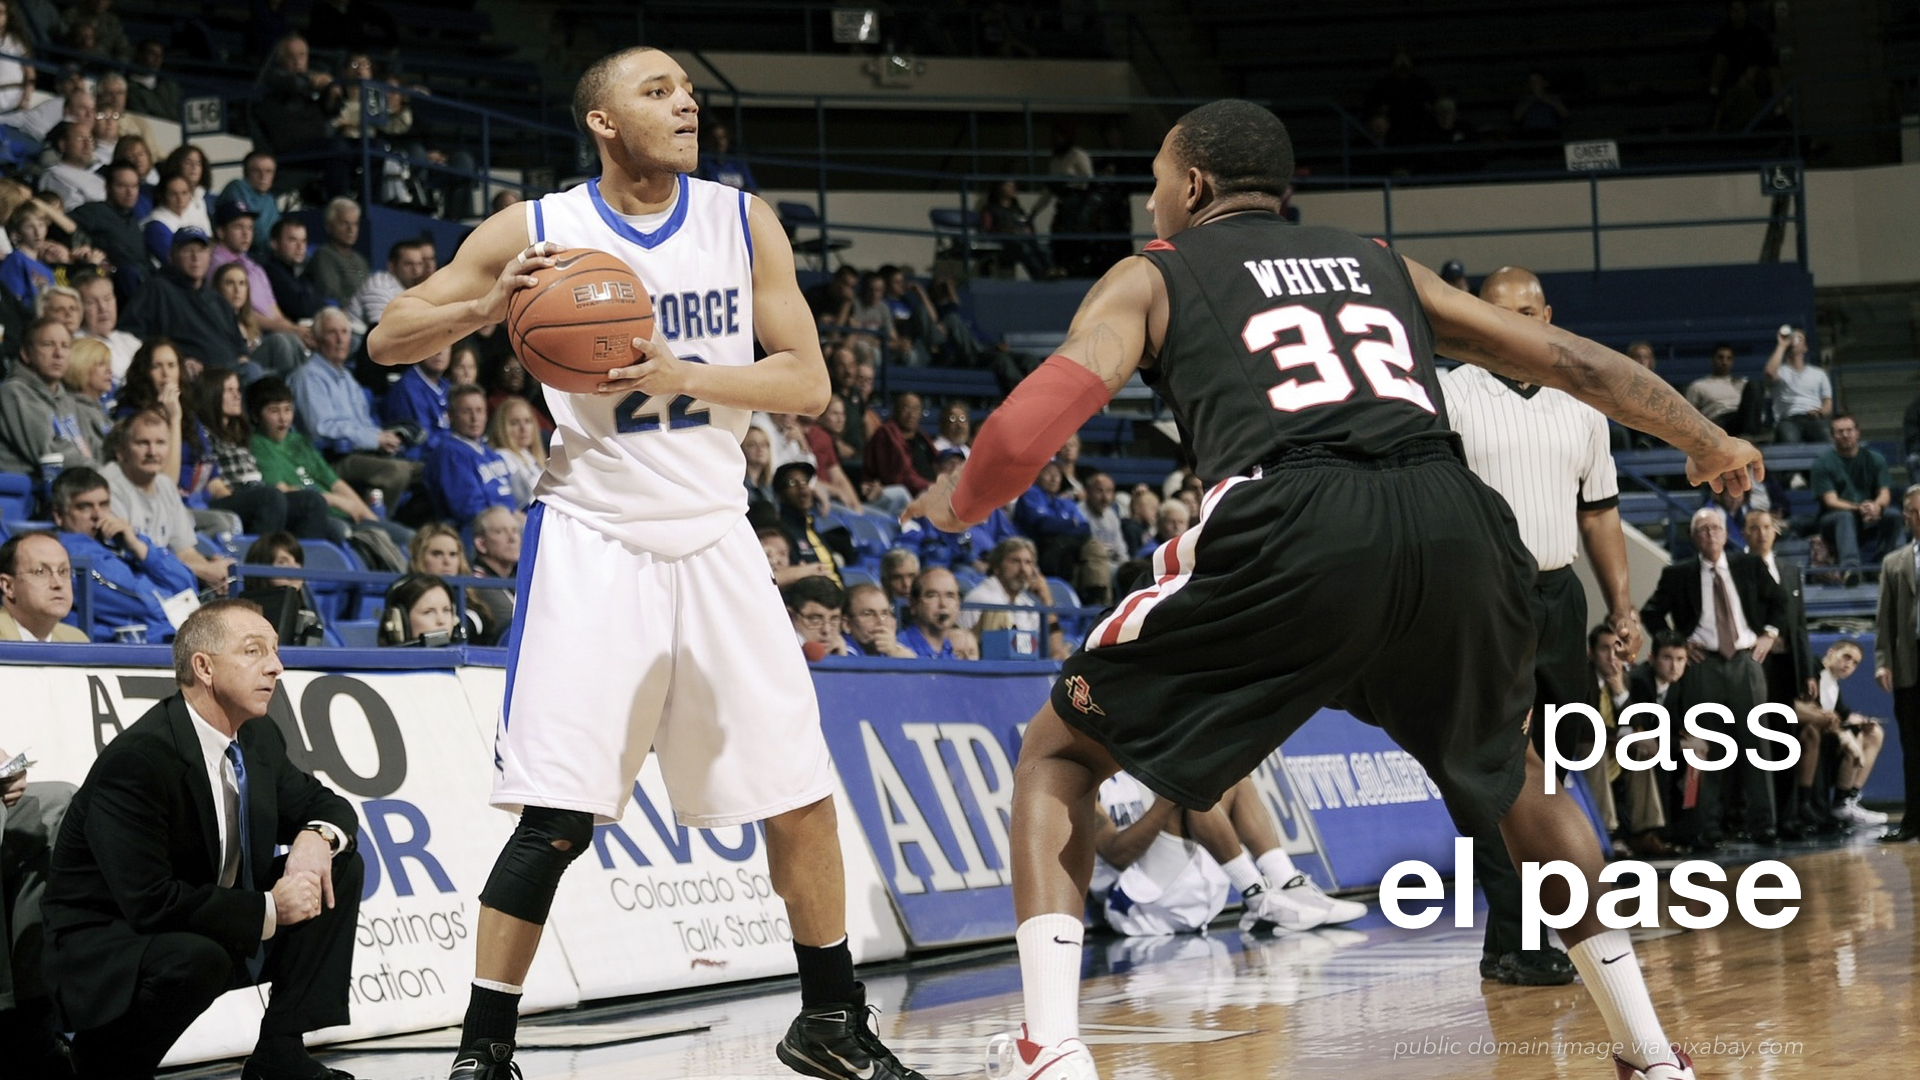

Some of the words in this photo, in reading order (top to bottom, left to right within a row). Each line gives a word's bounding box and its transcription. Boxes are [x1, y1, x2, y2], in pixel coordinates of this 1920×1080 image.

[187, 102, 221, 125] L16
[1244, 257, 1372, 298] WHITE
[1241, 303, 1438, 416] 32
[859, 720, 1013, 895] AIR
[610, 872, 736, 912] Colorado
[673, 917, 728, 954] Talk
